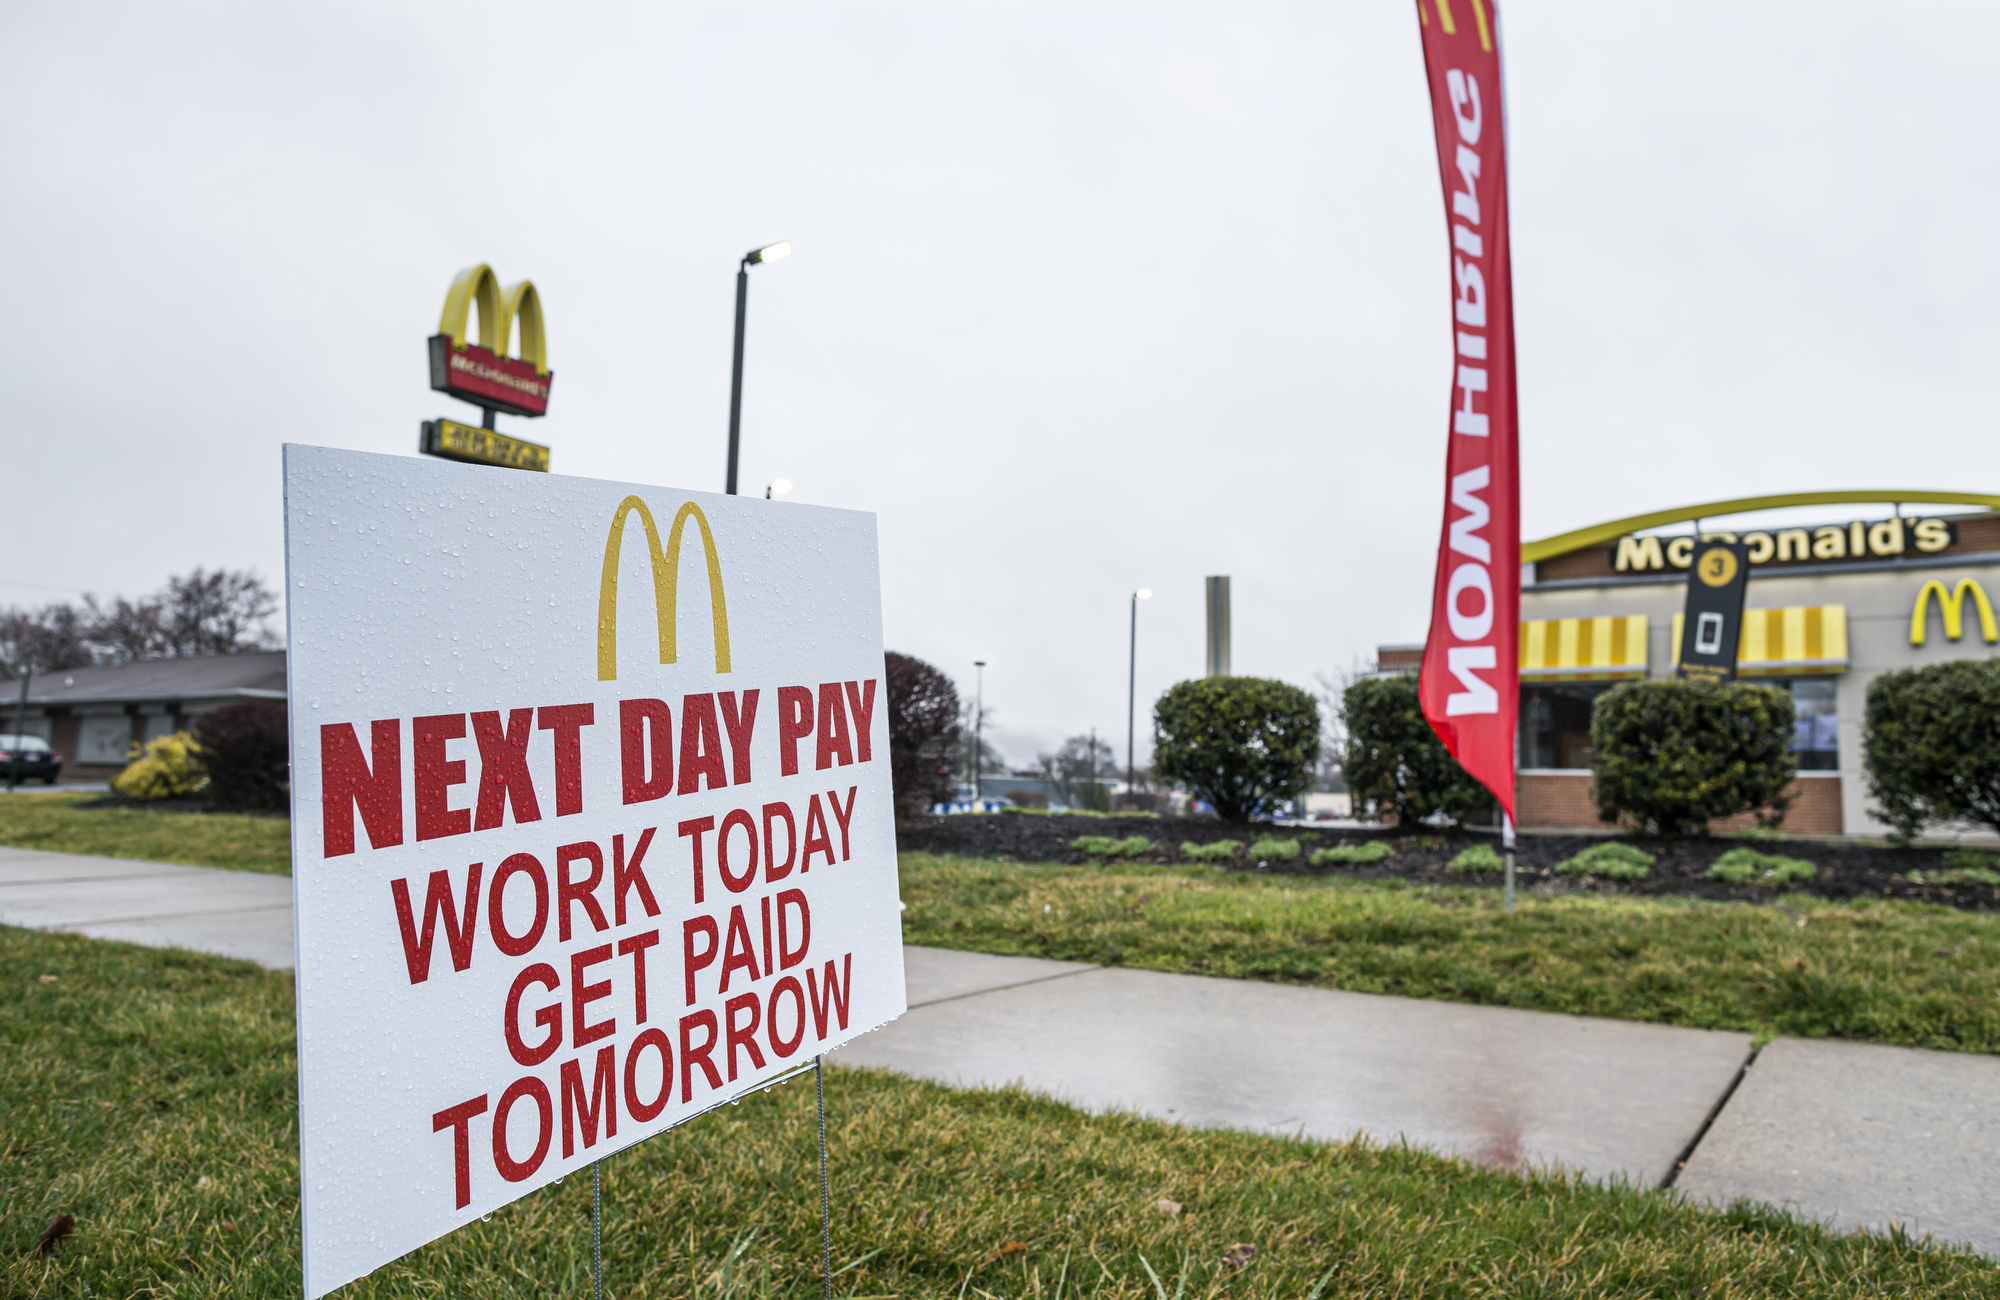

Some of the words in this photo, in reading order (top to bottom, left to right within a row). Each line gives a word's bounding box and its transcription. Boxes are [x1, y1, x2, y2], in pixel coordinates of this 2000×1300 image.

[1710, 557, 1725, 578] 3
[320, 703, 595, 859] NEXT
[619, 689, 760, 805] DAY
[777, 679, 877, 777] PAY
[390, 827, 661, 985] WORK
[678, 785, 857, 904] TODAY
[504, 929, 659, 1067] GET
[683, 888, 811, 1006] PAID
[432, 953, 852, 1211] TOMORROW
